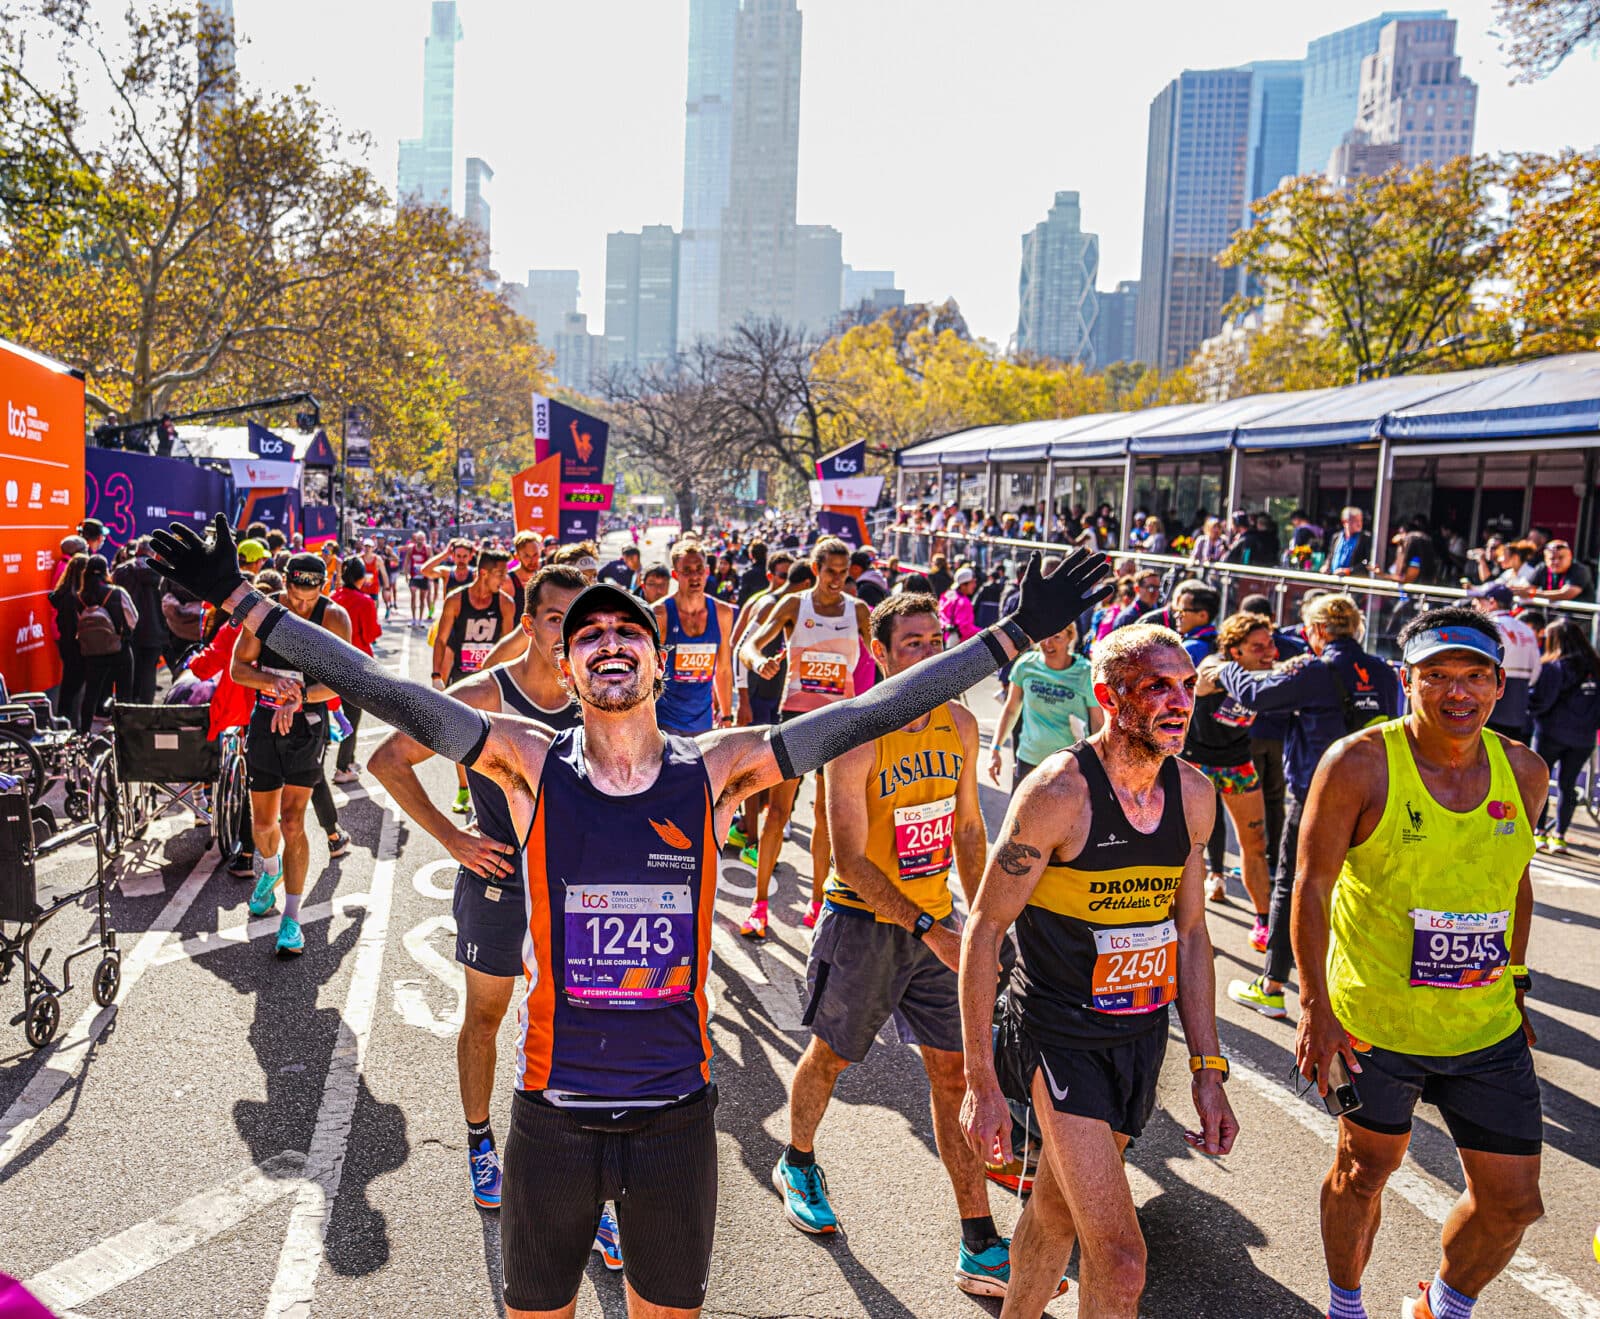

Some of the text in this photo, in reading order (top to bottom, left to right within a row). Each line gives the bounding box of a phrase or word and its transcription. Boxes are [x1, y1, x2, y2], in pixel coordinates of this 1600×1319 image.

[8, 400, 27, 438] tcs
[537, 403, 546, 433] 2023
[260, 438, 283, 453] tcs
[834, 457, 857, 472] tcs
[523, 480, 549, 497] tcs
[681, 654, 711, 667] 2402
[807, 662, 840, 678] 2254
[904, 811, 921, 821] tcs
[906, 815, 952, 849] 2644
[1089, 877, 1180, 894] DROMORE
[582, 890, 608, 909] tcs
[1088, 894, 1151, 912] Athletic
[1430, 916, 1454, 929] tcs
[586, 917, 674, 955] 1243
[1110, 934, 1131, 949] tcs
[1430, 934, 1500, 962] 9545
[588, 957, 593, 967] 1
[640, 957, 649, 967] A
[1106, 948, 1167, 983] 2450
